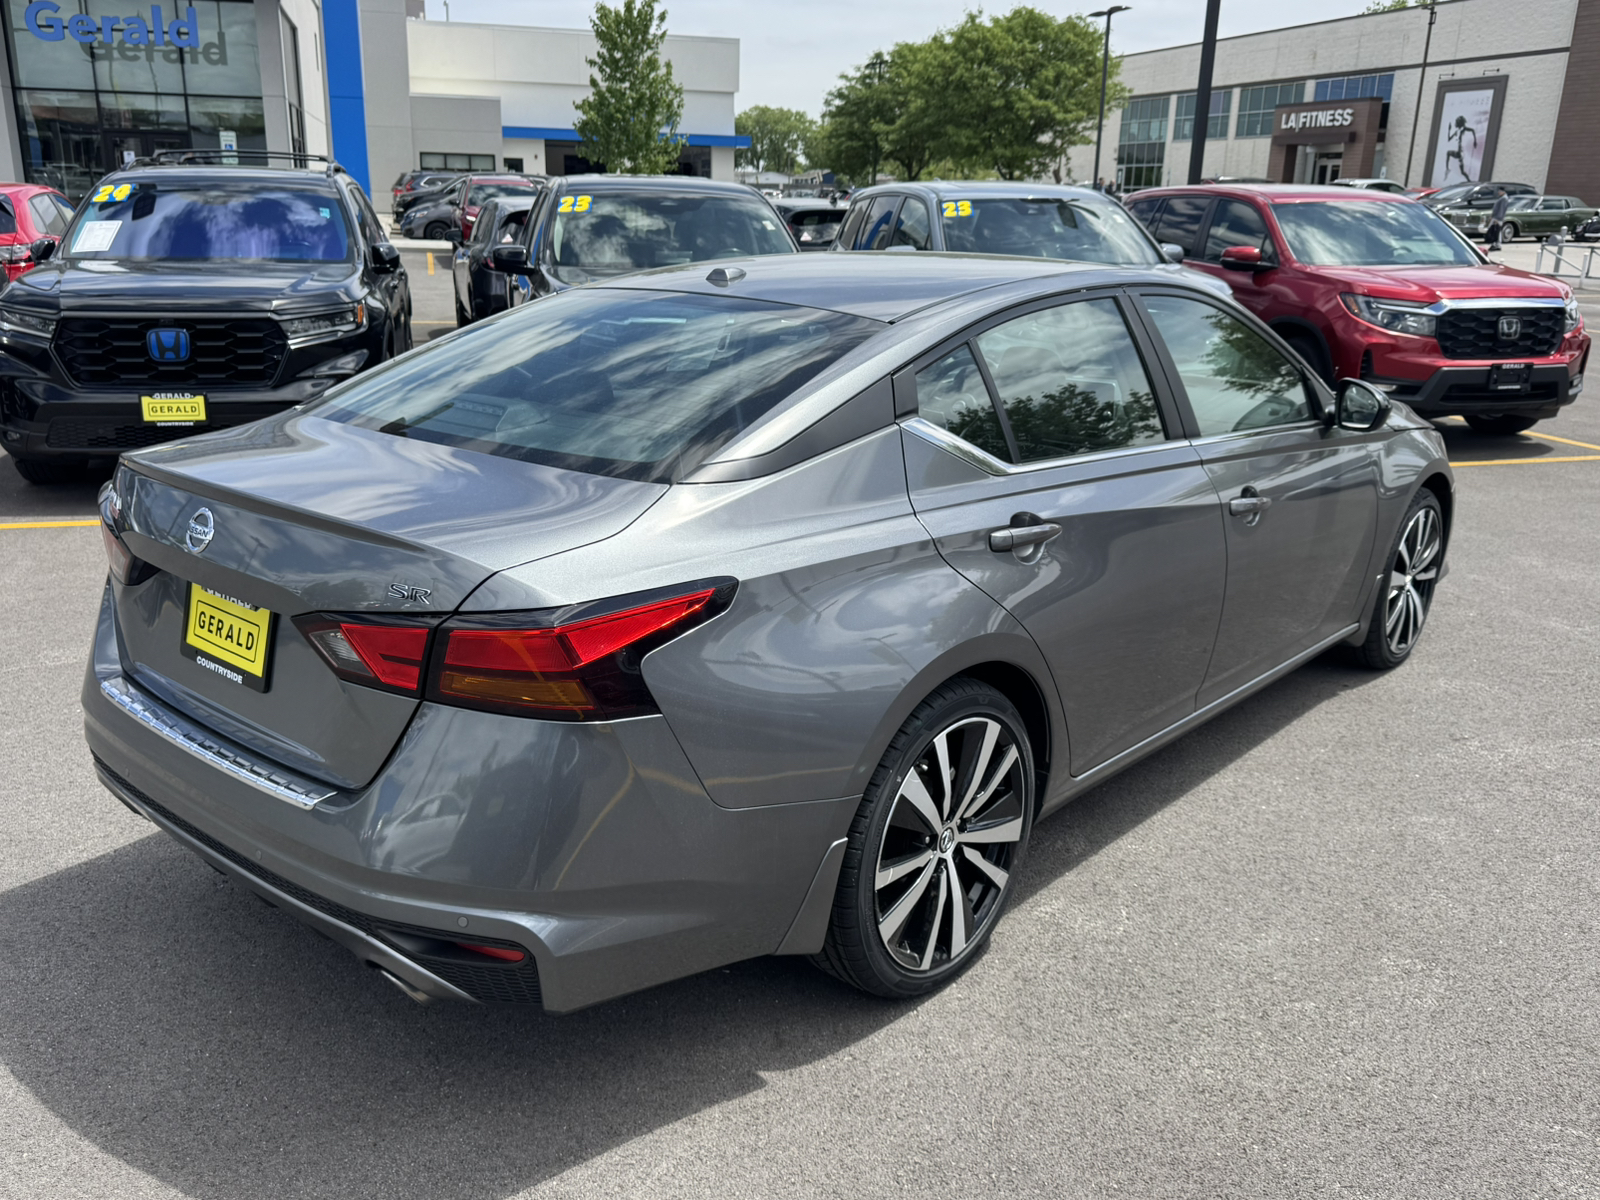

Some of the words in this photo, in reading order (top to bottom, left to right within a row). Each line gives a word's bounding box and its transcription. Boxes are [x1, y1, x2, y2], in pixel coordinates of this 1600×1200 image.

[24, 0, 199, 48] Gerald
[93, 184, 132, 203] 24
[558, 195, 592, 213] 23
[942, 201, 972, 217] 23
[151, 405, 197, 413] GERALD
[388, 582, 431, 604] SR
[198, 610, 255, 651] GERALD
[196, 655, 243, 684] COUNTRYSIDE
